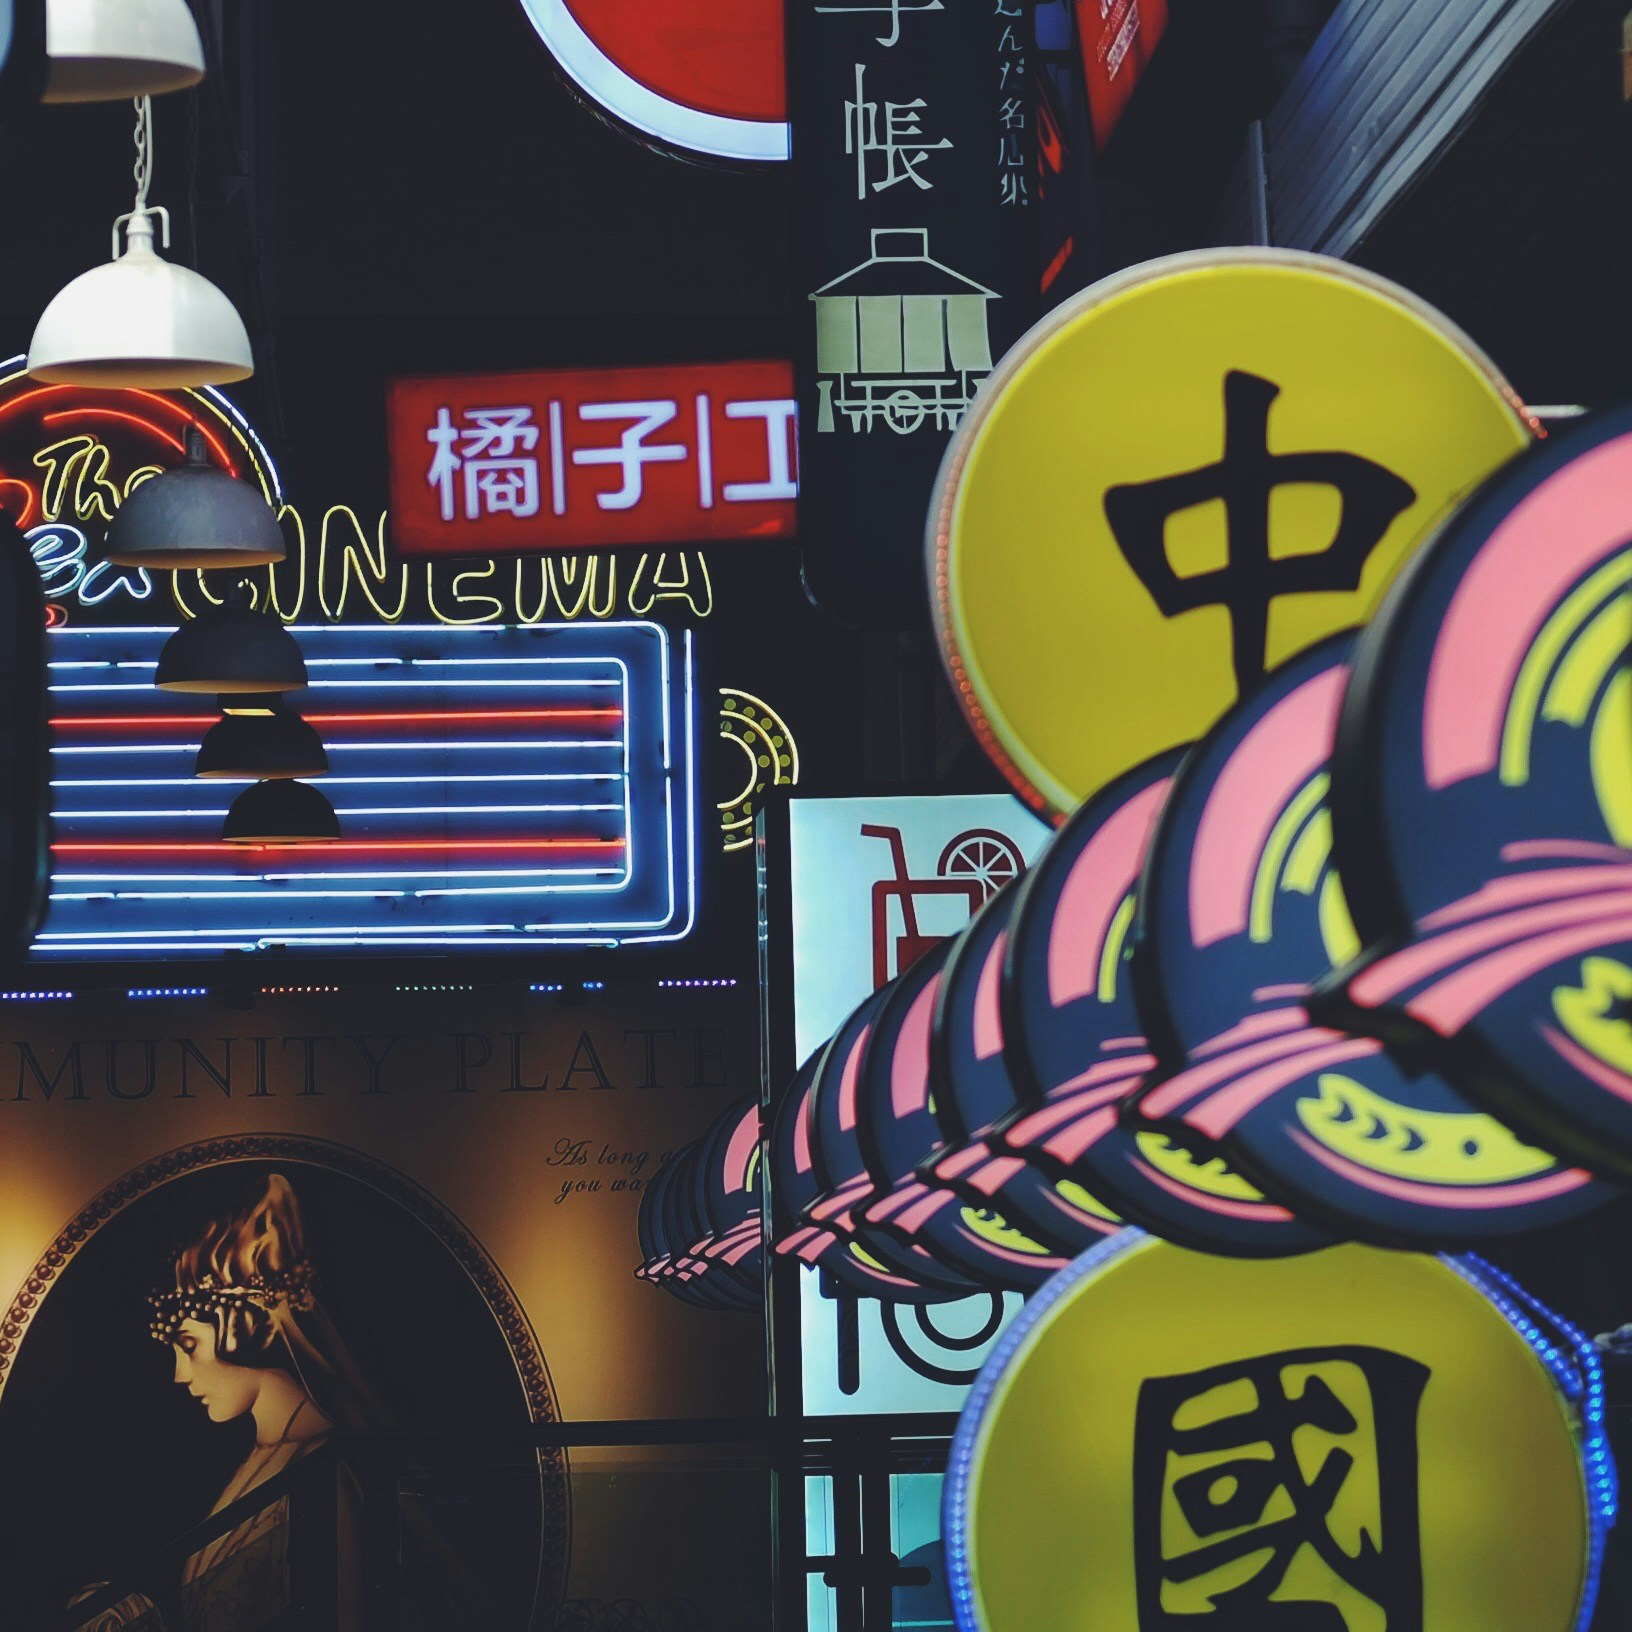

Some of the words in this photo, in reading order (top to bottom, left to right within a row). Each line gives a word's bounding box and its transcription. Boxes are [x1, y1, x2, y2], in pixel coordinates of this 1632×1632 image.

[1102, 367, 1419, 702] 中
[448, 1028, 729, 1094] PLATE
[546, 1137, 593, 1167] As
[597, 1144, 650, 1175] long
[553, 1178, 602, 1206] you
[1131, 1344, 1432, 1632] 國
